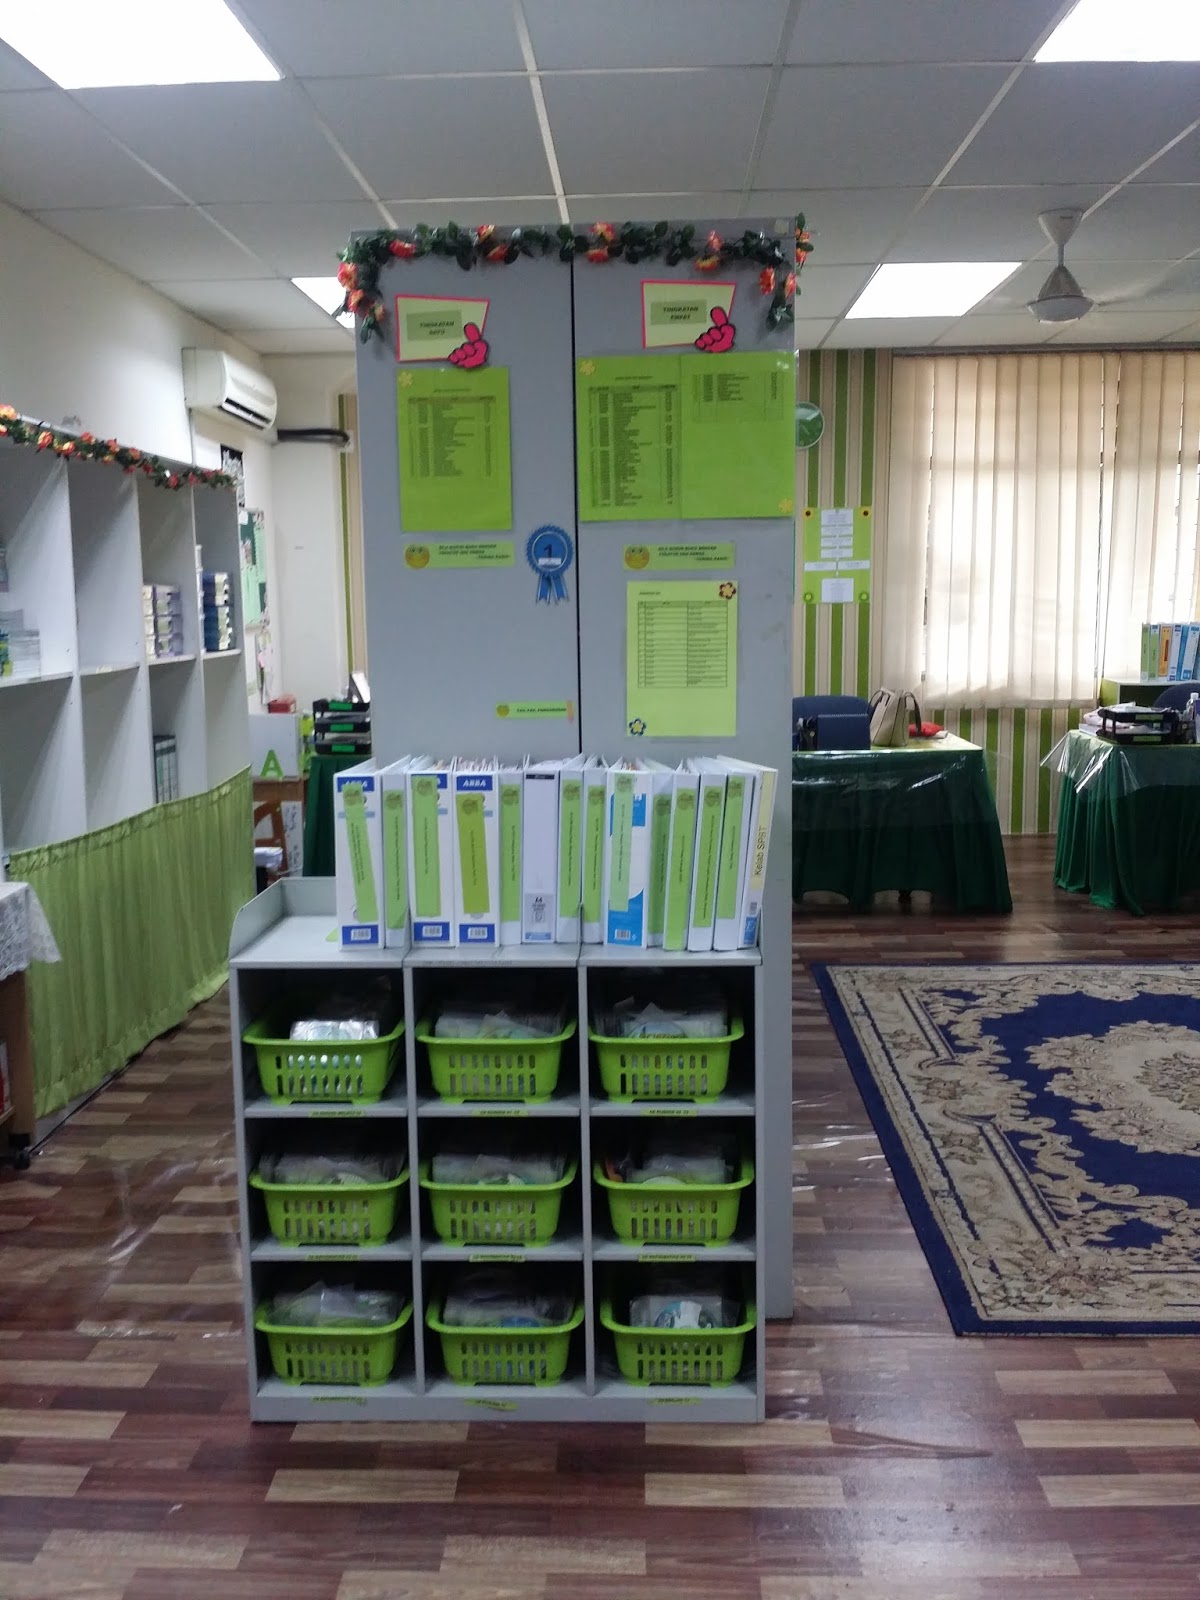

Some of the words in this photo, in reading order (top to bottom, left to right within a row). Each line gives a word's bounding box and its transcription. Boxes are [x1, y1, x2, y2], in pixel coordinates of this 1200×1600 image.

[663, 305, 699, 313] TINGKATAN
[543, 543, 553, 559] 1
[260, 749, 284, 779] A
[462, 778, 487, 788] ABBA
[754, 851, 765, 876] Kelab
